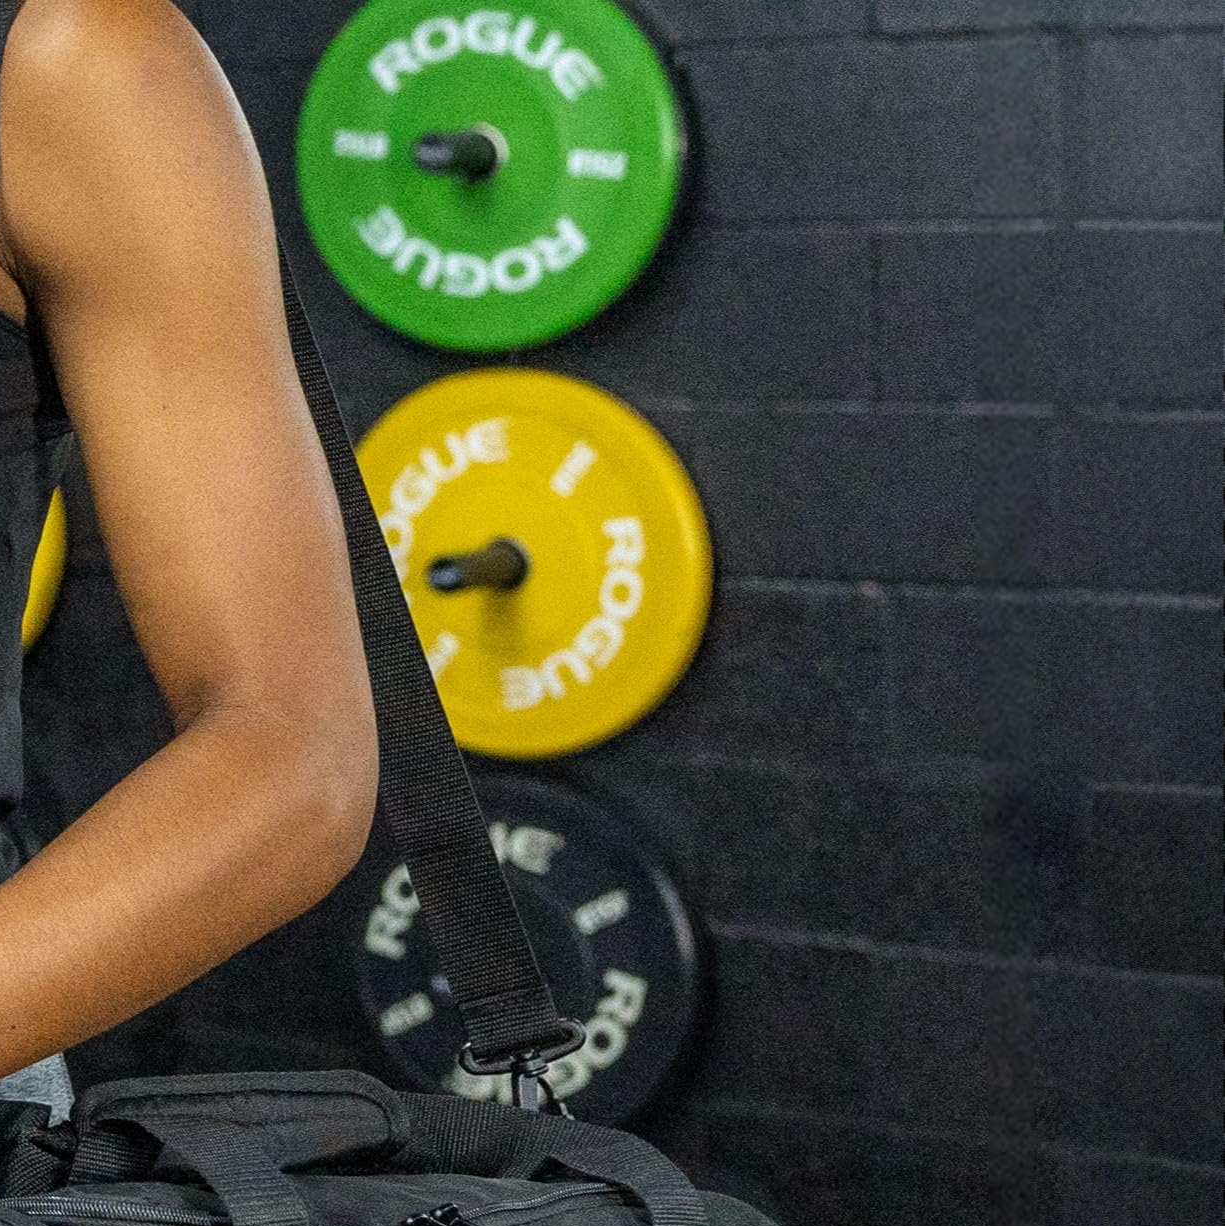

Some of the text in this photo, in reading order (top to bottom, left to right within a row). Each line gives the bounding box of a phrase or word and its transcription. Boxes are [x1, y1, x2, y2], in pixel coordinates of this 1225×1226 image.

[368, 10, 606, 99] ROGUE
[351, 206, 589, 298] ROGUE
[380, 417, 510, 581] OGUE
[501, 515, 645, 711] ROGUE
